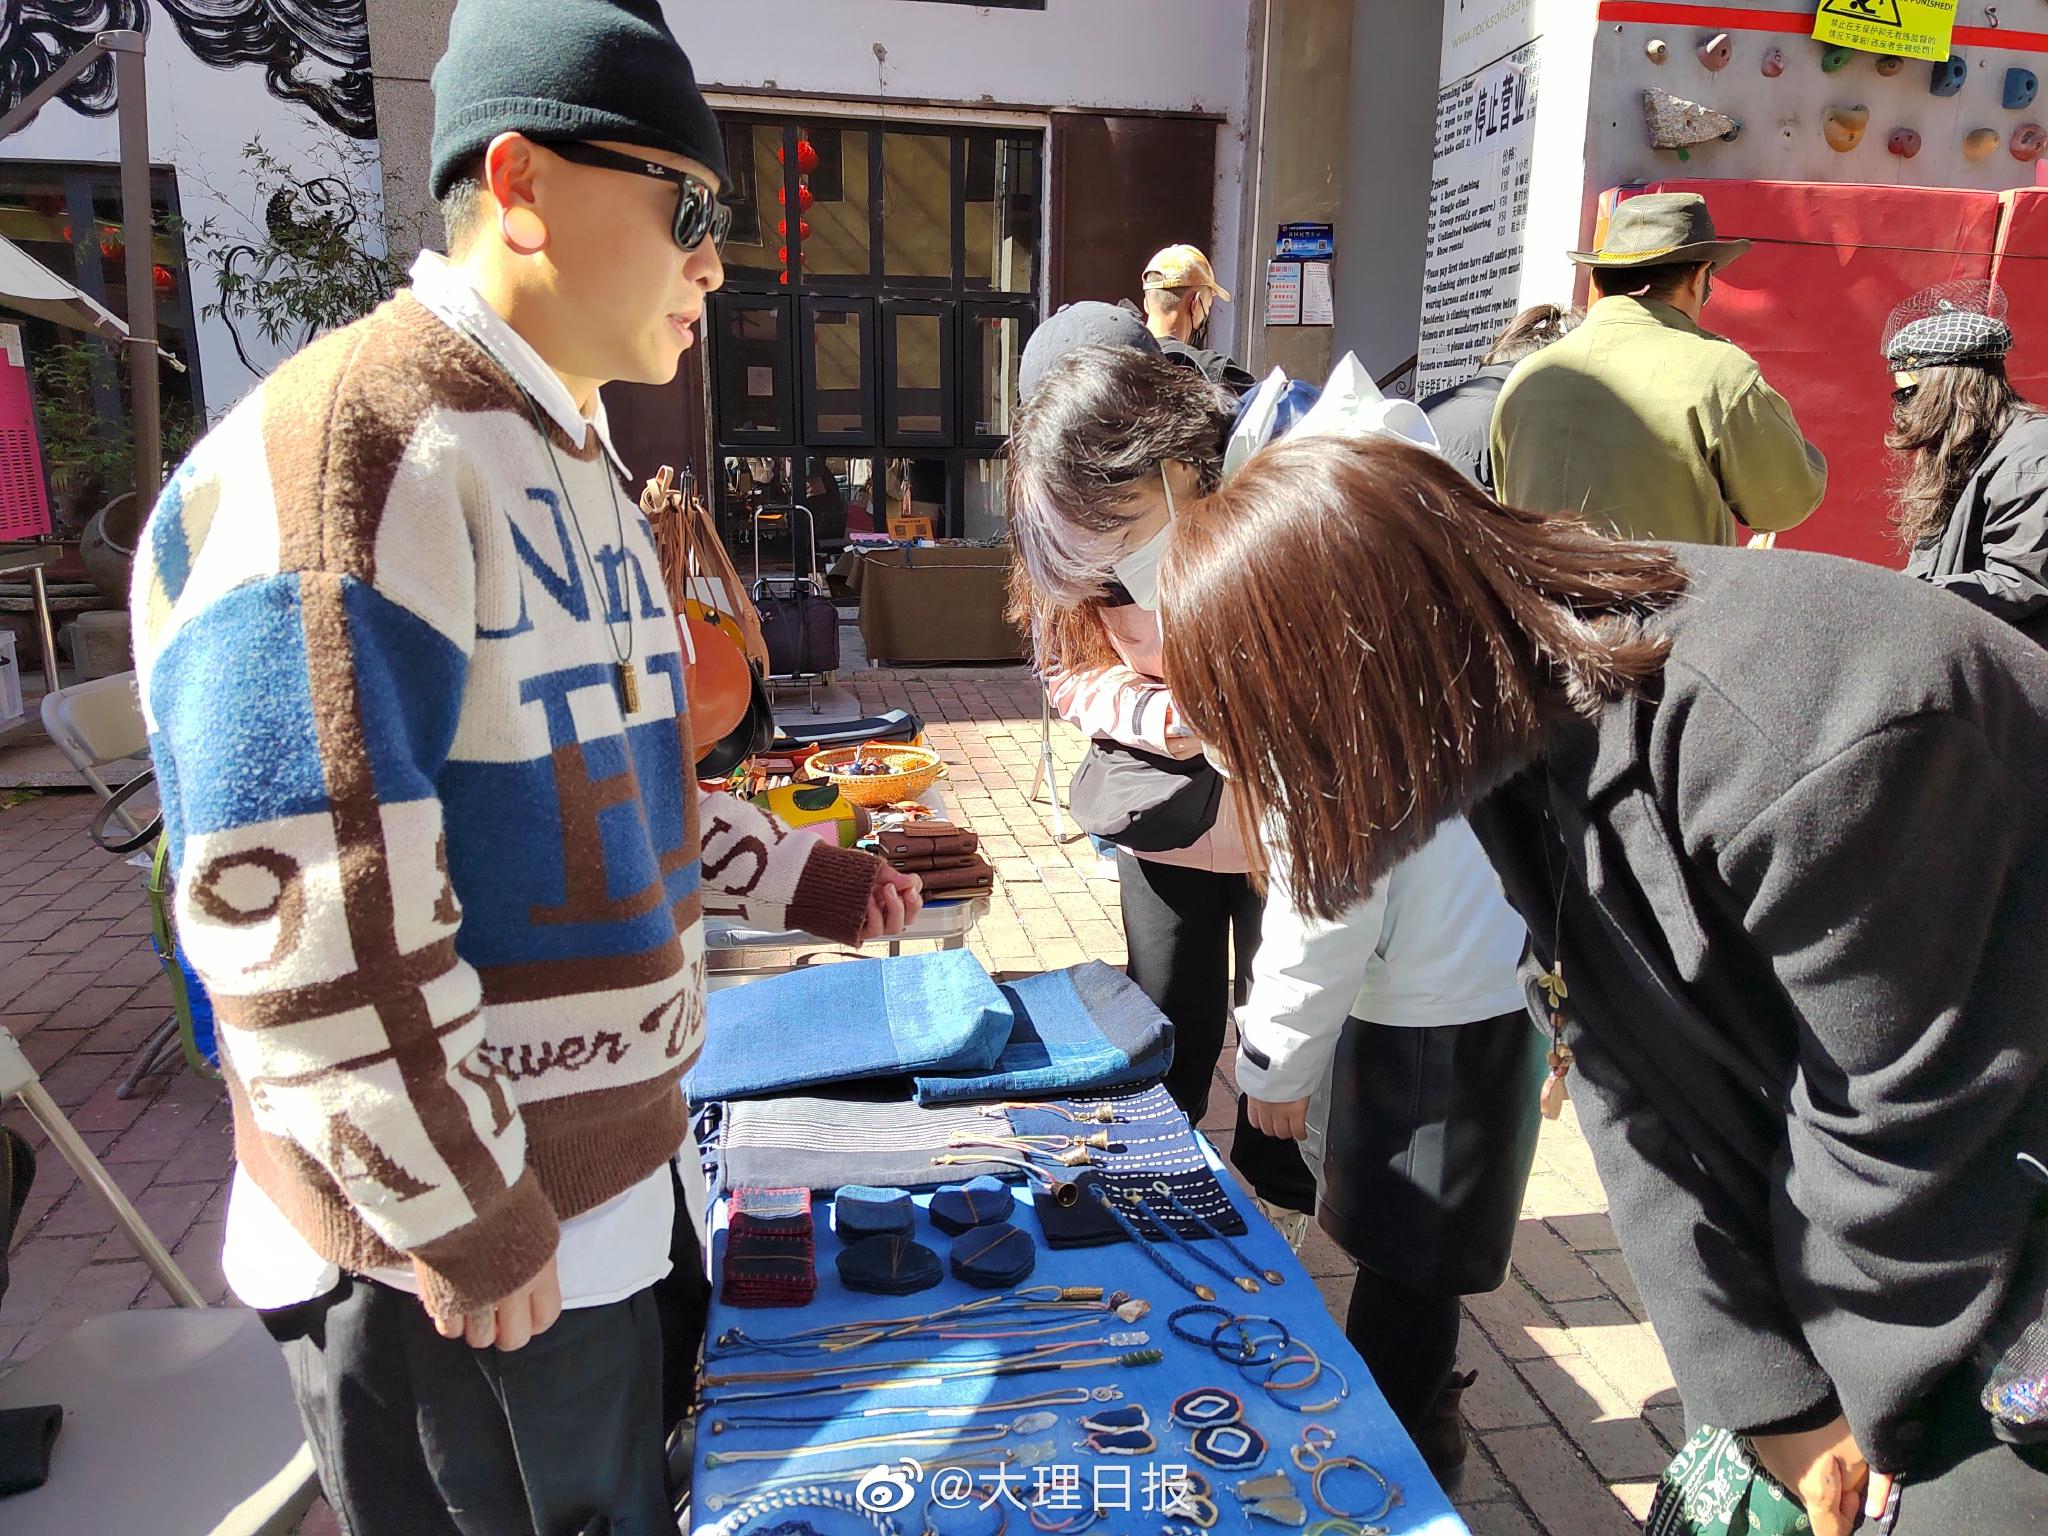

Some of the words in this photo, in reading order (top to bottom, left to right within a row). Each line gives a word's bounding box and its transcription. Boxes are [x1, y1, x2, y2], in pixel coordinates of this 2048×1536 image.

[1831, 18, 1936, 45] 禁止在无保护和无教练监督的
[1475, 72, 1527, 146] 停止营业
[1458, 180, 1480, 194] climbing
[1440, 202, 1454, 214] Single
[1455, 196, 1470, 209] climb
[1437, 227, 1462, 242] Unlimited
[1462, 219, 1492, 235] bouldering
[1439, 217, 1454, 228] Group
[1437, 247, 1448, 256] Shoe
[1449, 239, 1464, 253] rental
[1470, 257, 1481, 268] have
[1482, 251, 1494, 264] staff
[1508, 246, 1517, 260] you
[1438, 280, 1455, 291] climbing
[1456, 276, 1469, 287] above
[1470, 273, 1478, 284] the
[1479, 269, 1488, 281] red
[1489, 268, 1497, 280] line
[1498, 267, 1507, 279] you
[1426, 299, 1441, 310] wearing
[1442, 296, 1458, 307] harness
[1459, 290, 1468, 302] and
[1469, 291, 1474, 300] on
[1451, 308, 1469, 320] climbing
[1471, 303, 1490, 315] without
[1491, 302, 1502, 313] rope
[1503, 297, 1517, 310] below
[1454, 323, 1480, 334] mandatory
[1480, 320, 1489, 330] but
[1494, 318, 1504, 330] you
[1474, 335, 1486, 348] staff
[1444, 356, 1467, 367] mandatory
